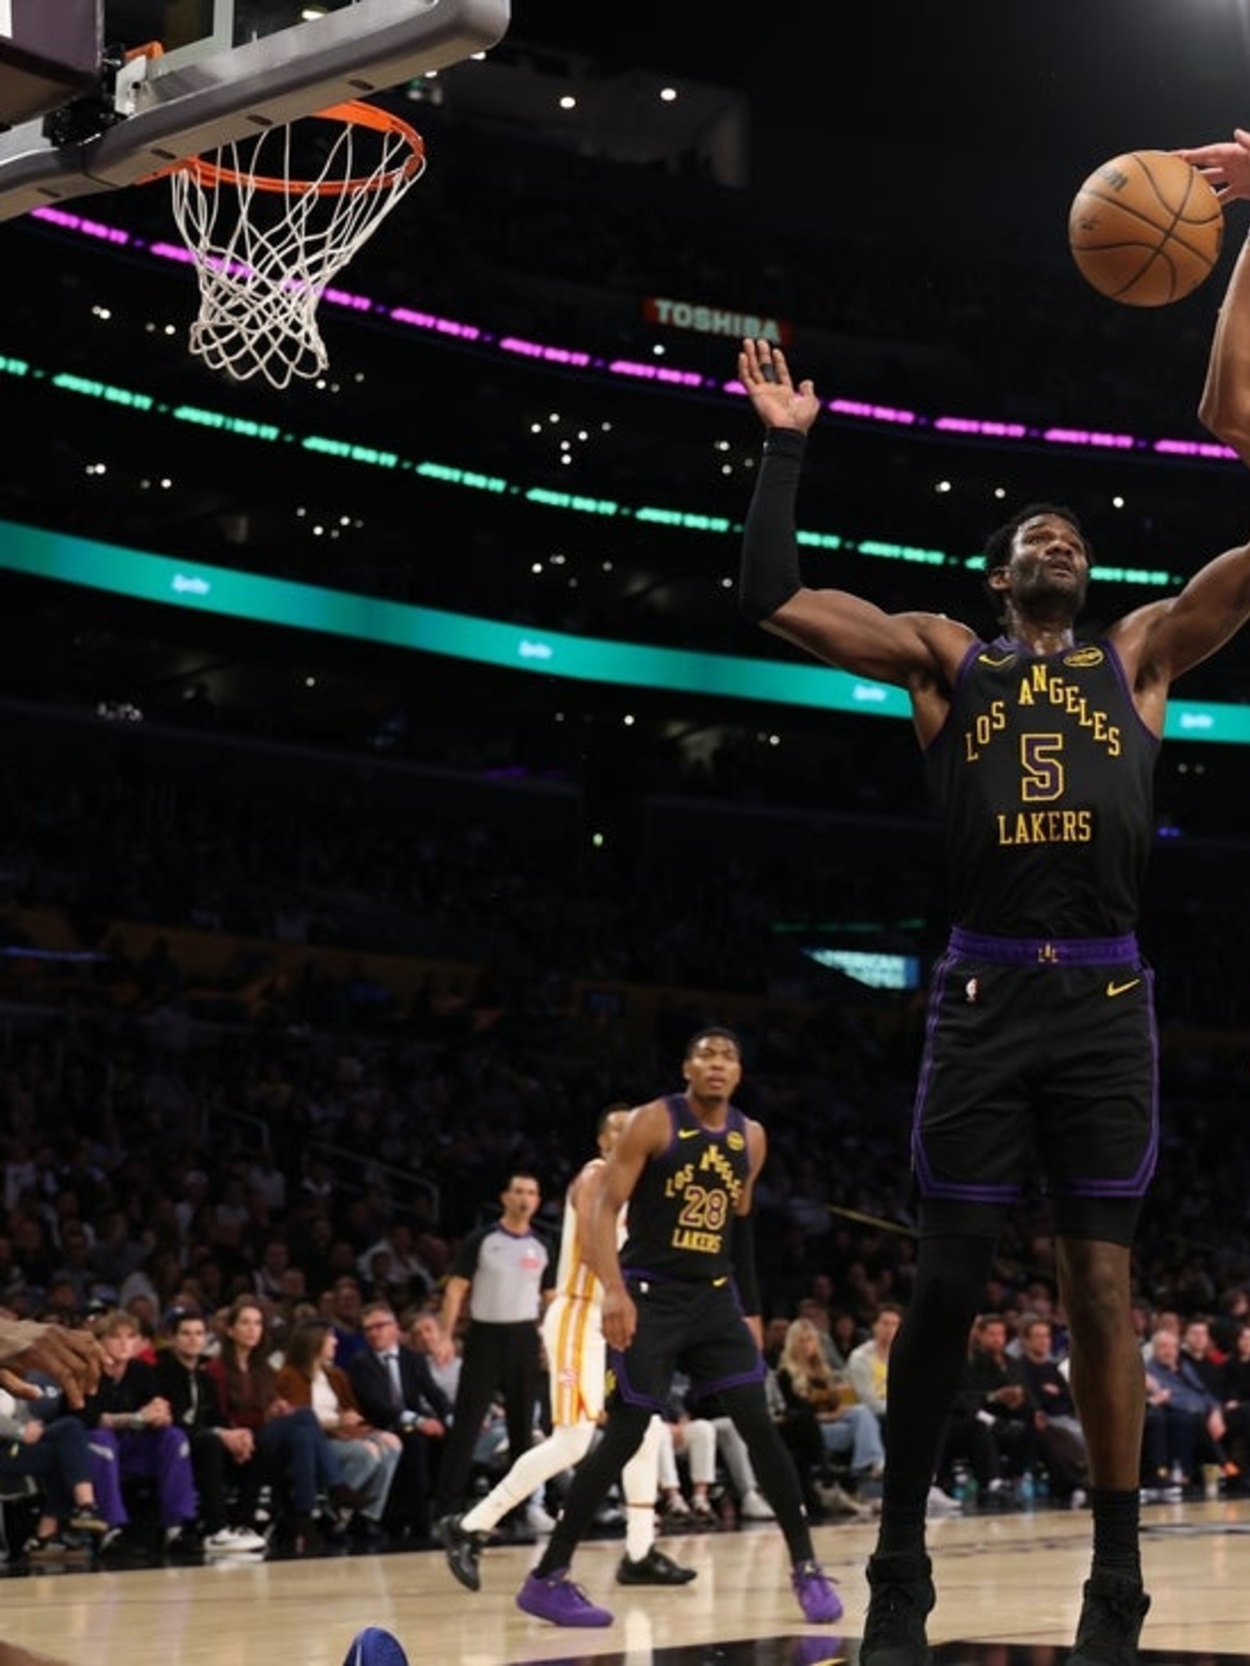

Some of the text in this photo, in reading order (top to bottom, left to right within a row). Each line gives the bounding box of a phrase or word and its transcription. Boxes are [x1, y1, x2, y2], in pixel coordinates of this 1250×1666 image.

[654, 299, 780, 344] TOSHIBA
[965, 664, 1121, 762] LOS ANGELES
[1021, 733, 1064, 801] 5
[998, 811, 1092, 845] LAKERS
[664, 1163, 695, 1198] LOS
[678, 1185, 728, 1231] 28
[673, 1229, 722, 1253] LAKERS
